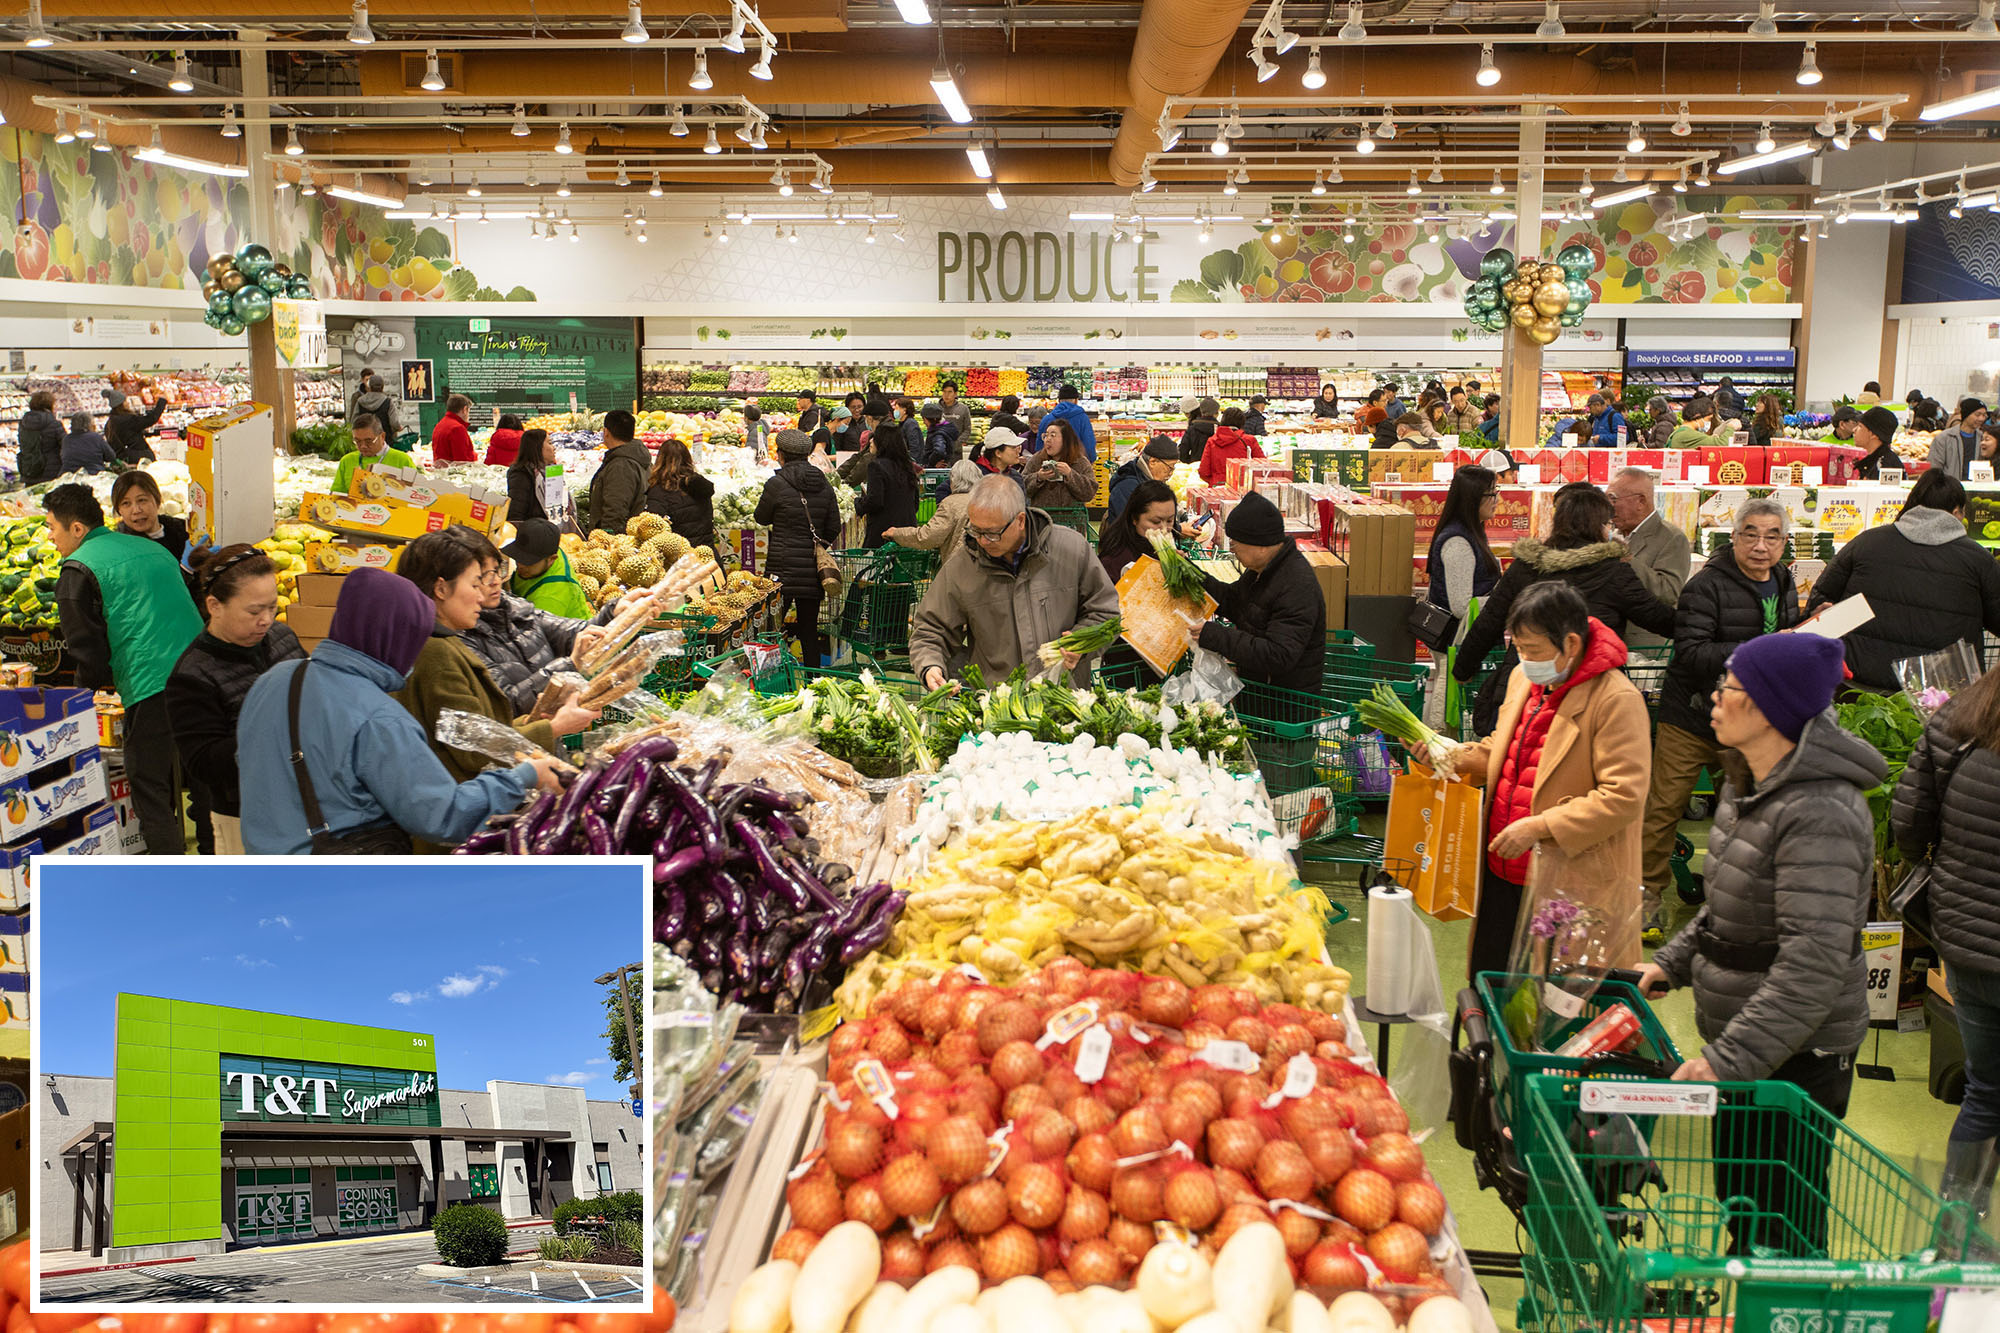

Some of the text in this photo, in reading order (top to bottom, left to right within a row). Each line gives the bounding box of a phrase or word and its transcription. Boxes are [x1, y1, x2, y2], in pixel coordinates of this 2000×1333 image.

[938, 230, 1160, 303] PRODUCE
[278, 326, 297, 339] DROP
[1637, 355, 1660, 364] Ready
[1694, 354, 1743, 362] SEAFOOD
[361, 509, 385, 520] Zespri
[365, 552, 388, 563] Zespri
[413, 1038, 426, 1046] 501
[226, 1072, 434, 1122] T&T Supermarket
[344, 1188, 390, 1201] COMING
[345, 1201, 392, 1219] SOON
